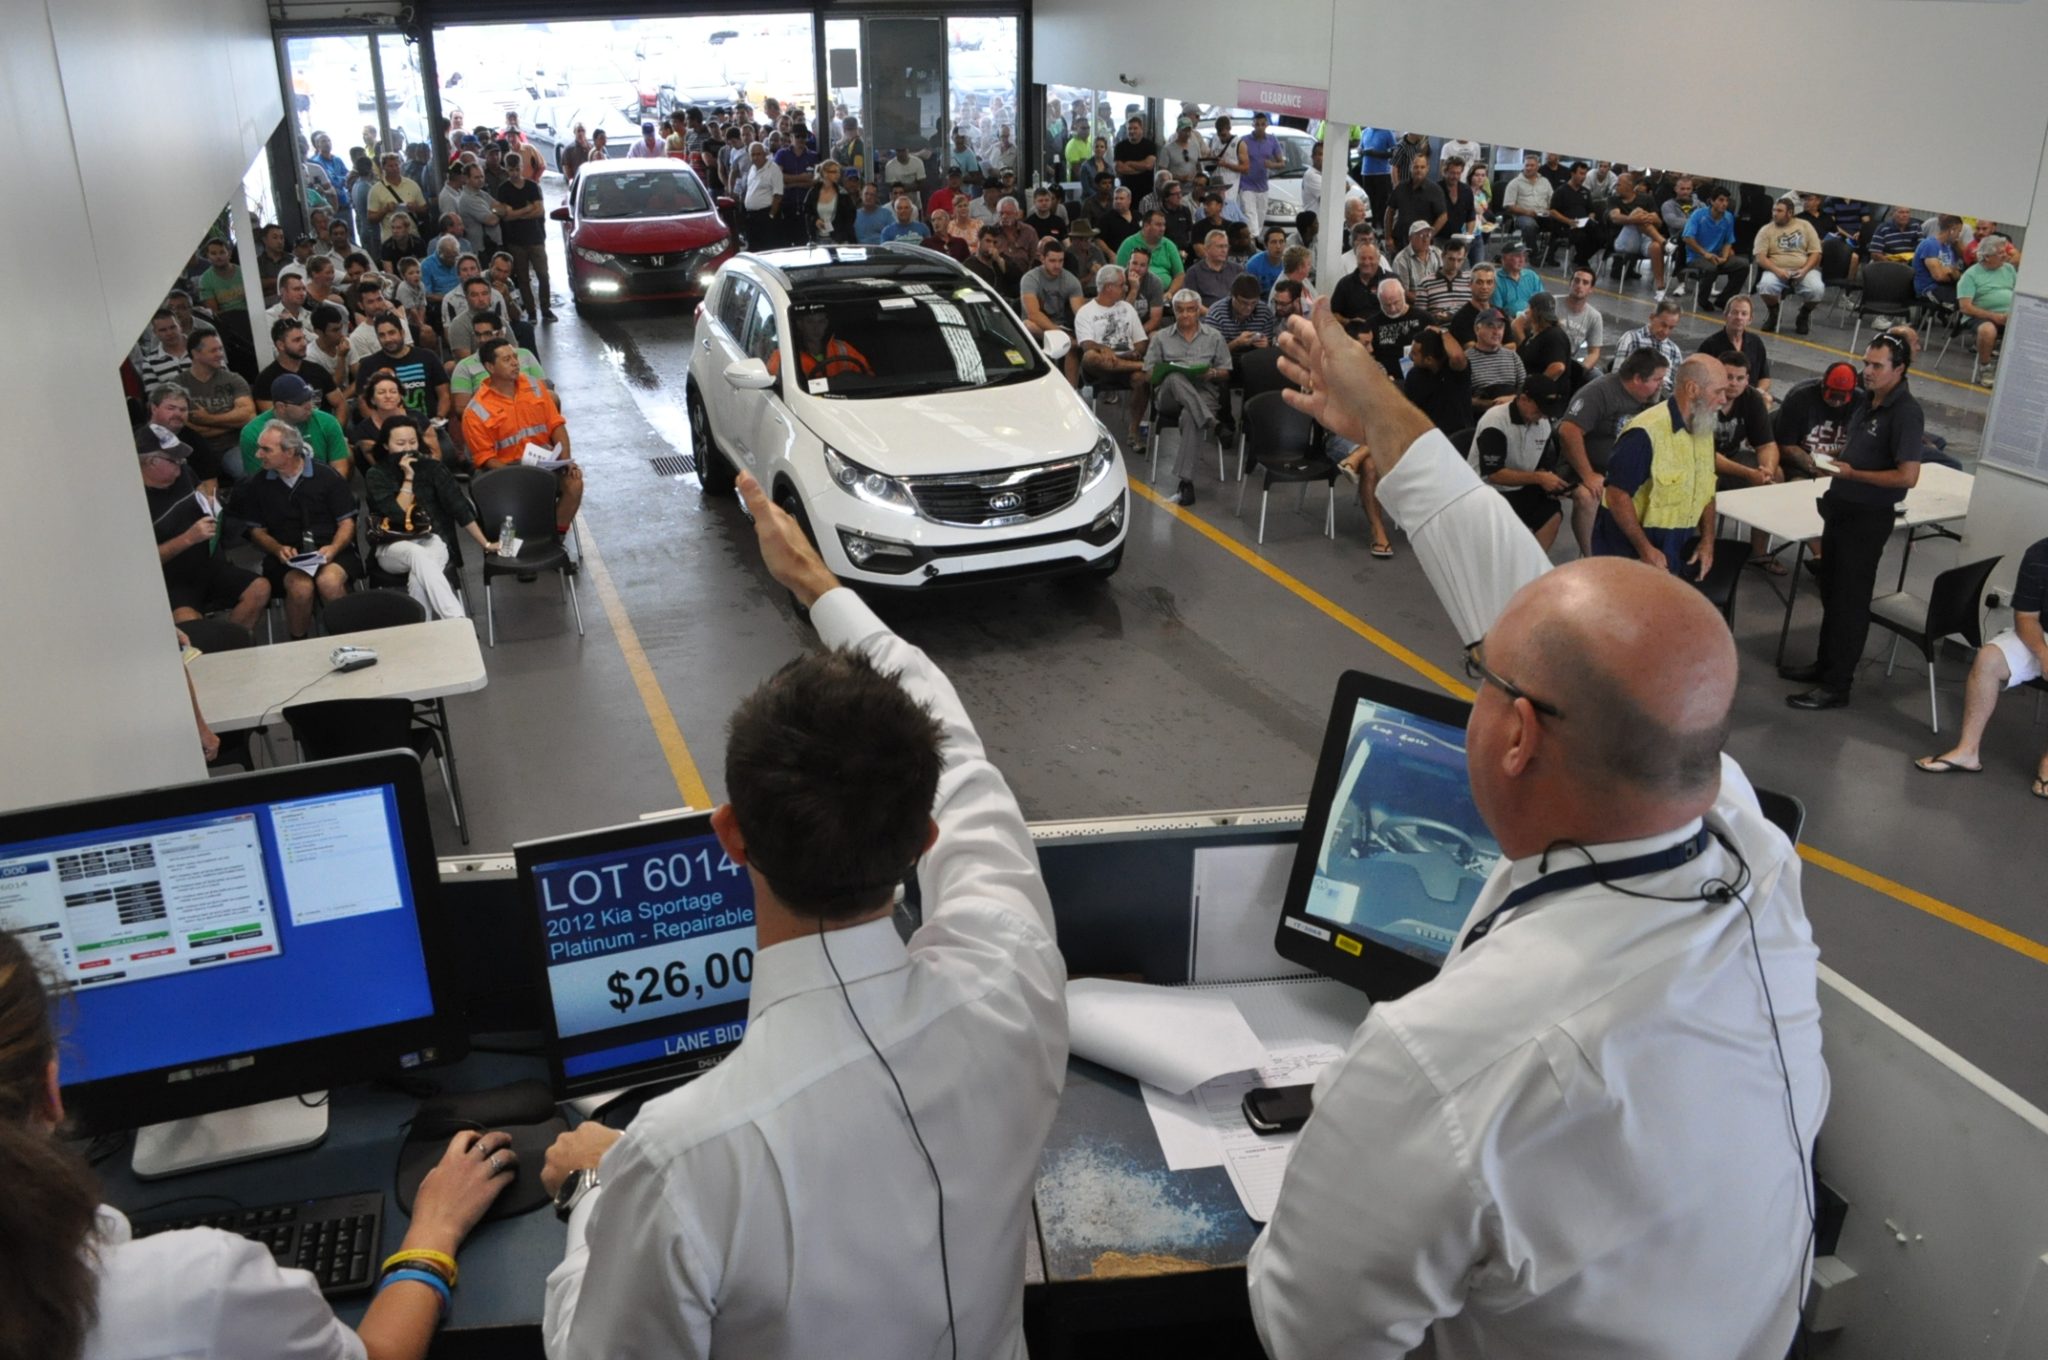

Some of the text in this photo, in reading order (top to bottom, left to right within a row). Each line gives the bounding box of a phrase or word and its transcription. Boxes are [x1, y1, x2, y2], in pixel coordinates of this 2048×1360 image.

[1260, 90, 1302, 109] CLEARANCE
[994, 495, 1018, 509] KIA
[542, 848, 740, 912] LOT 6014
[546, 890, 723, 938] 2012 Kia Sportage
[550, 930, 635, 960] Platinum
[653, 907, 753, 939] Repairable
[664, 1024, 743, 1056] LANE BID
